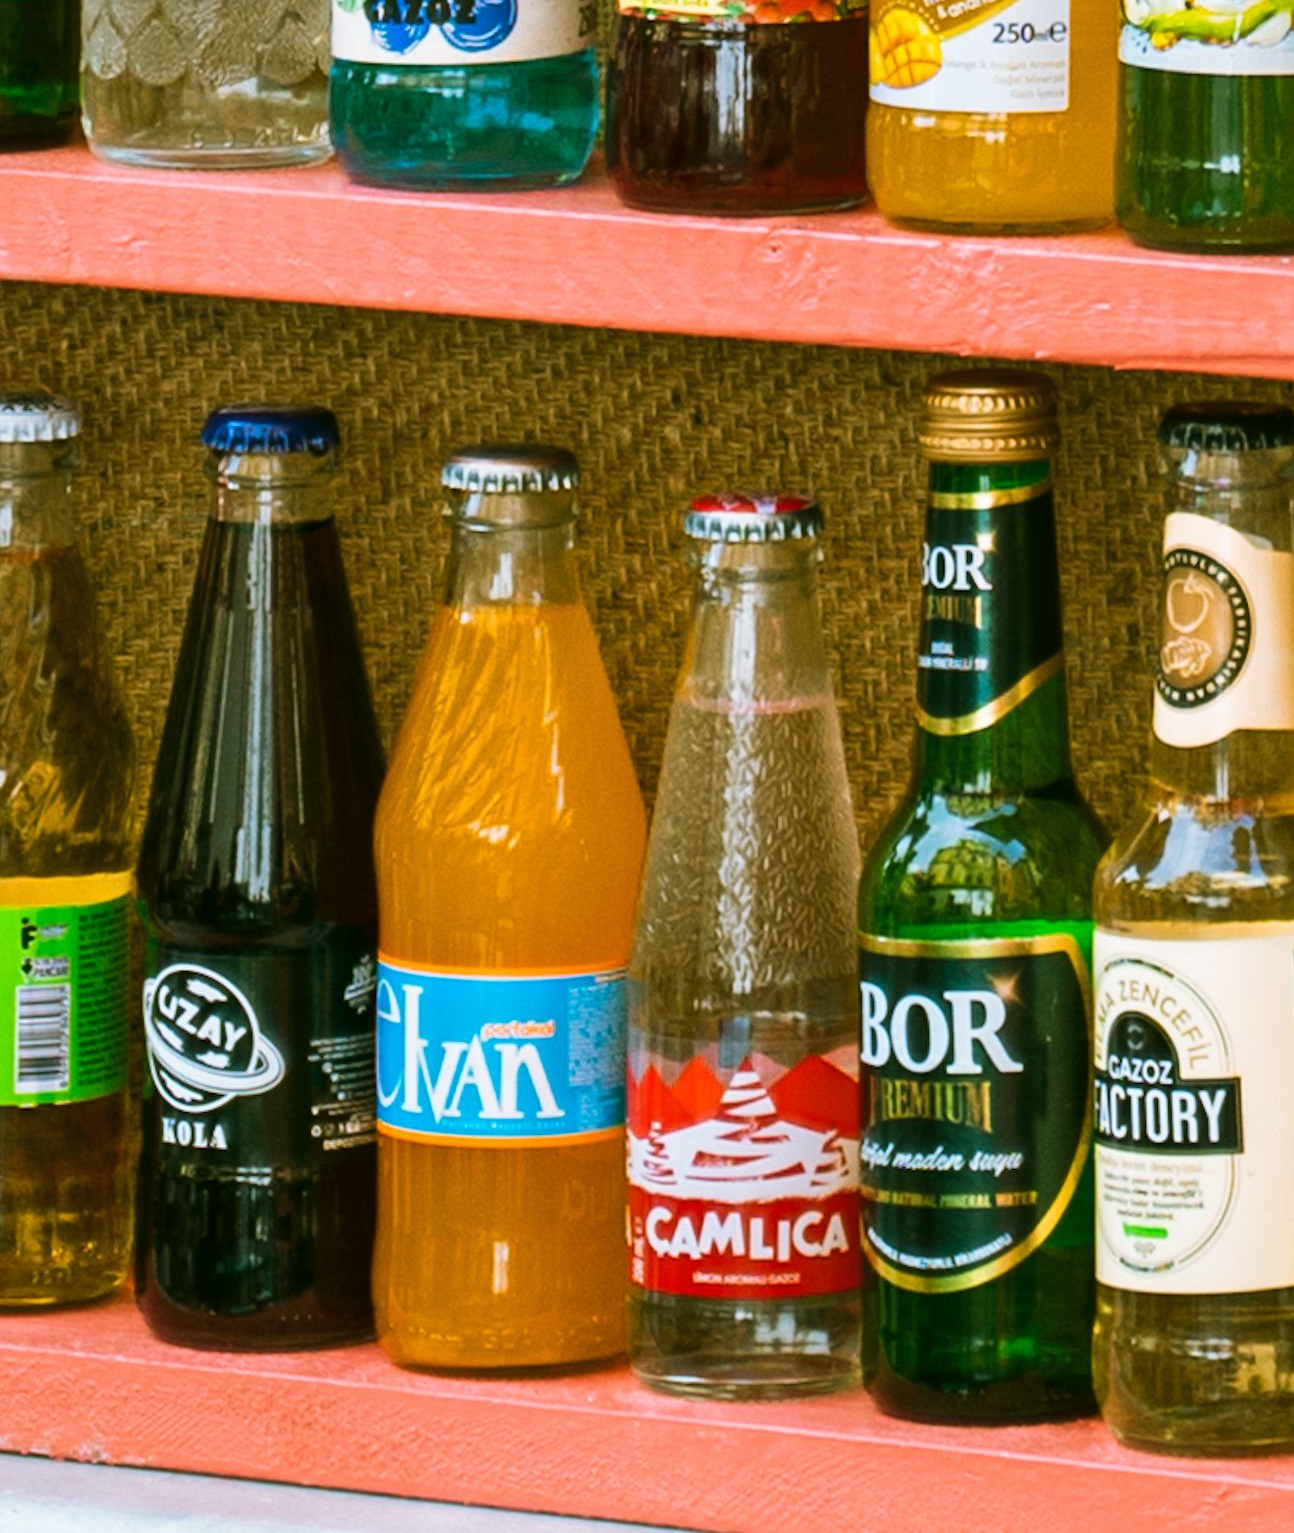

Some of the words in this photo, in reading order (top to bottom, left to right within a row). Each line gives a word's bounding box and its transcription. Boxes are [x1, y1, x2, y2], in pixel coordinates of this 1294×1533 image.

[157, 984, 247, 1054] UZAY
[859, 981, 1024, 1075] BOR
[1118, 979, 1211, 1070] ZENCEFİL
[1107, 1057, 1174, 1085] GAZOZ
[161, 1116, 229, 1150] KOLA
[871, 1077, 993, 1134] PREMIUM
[893, 1143, 965, 1172] maden
[969, 1151, 1024, 1178] suyu
